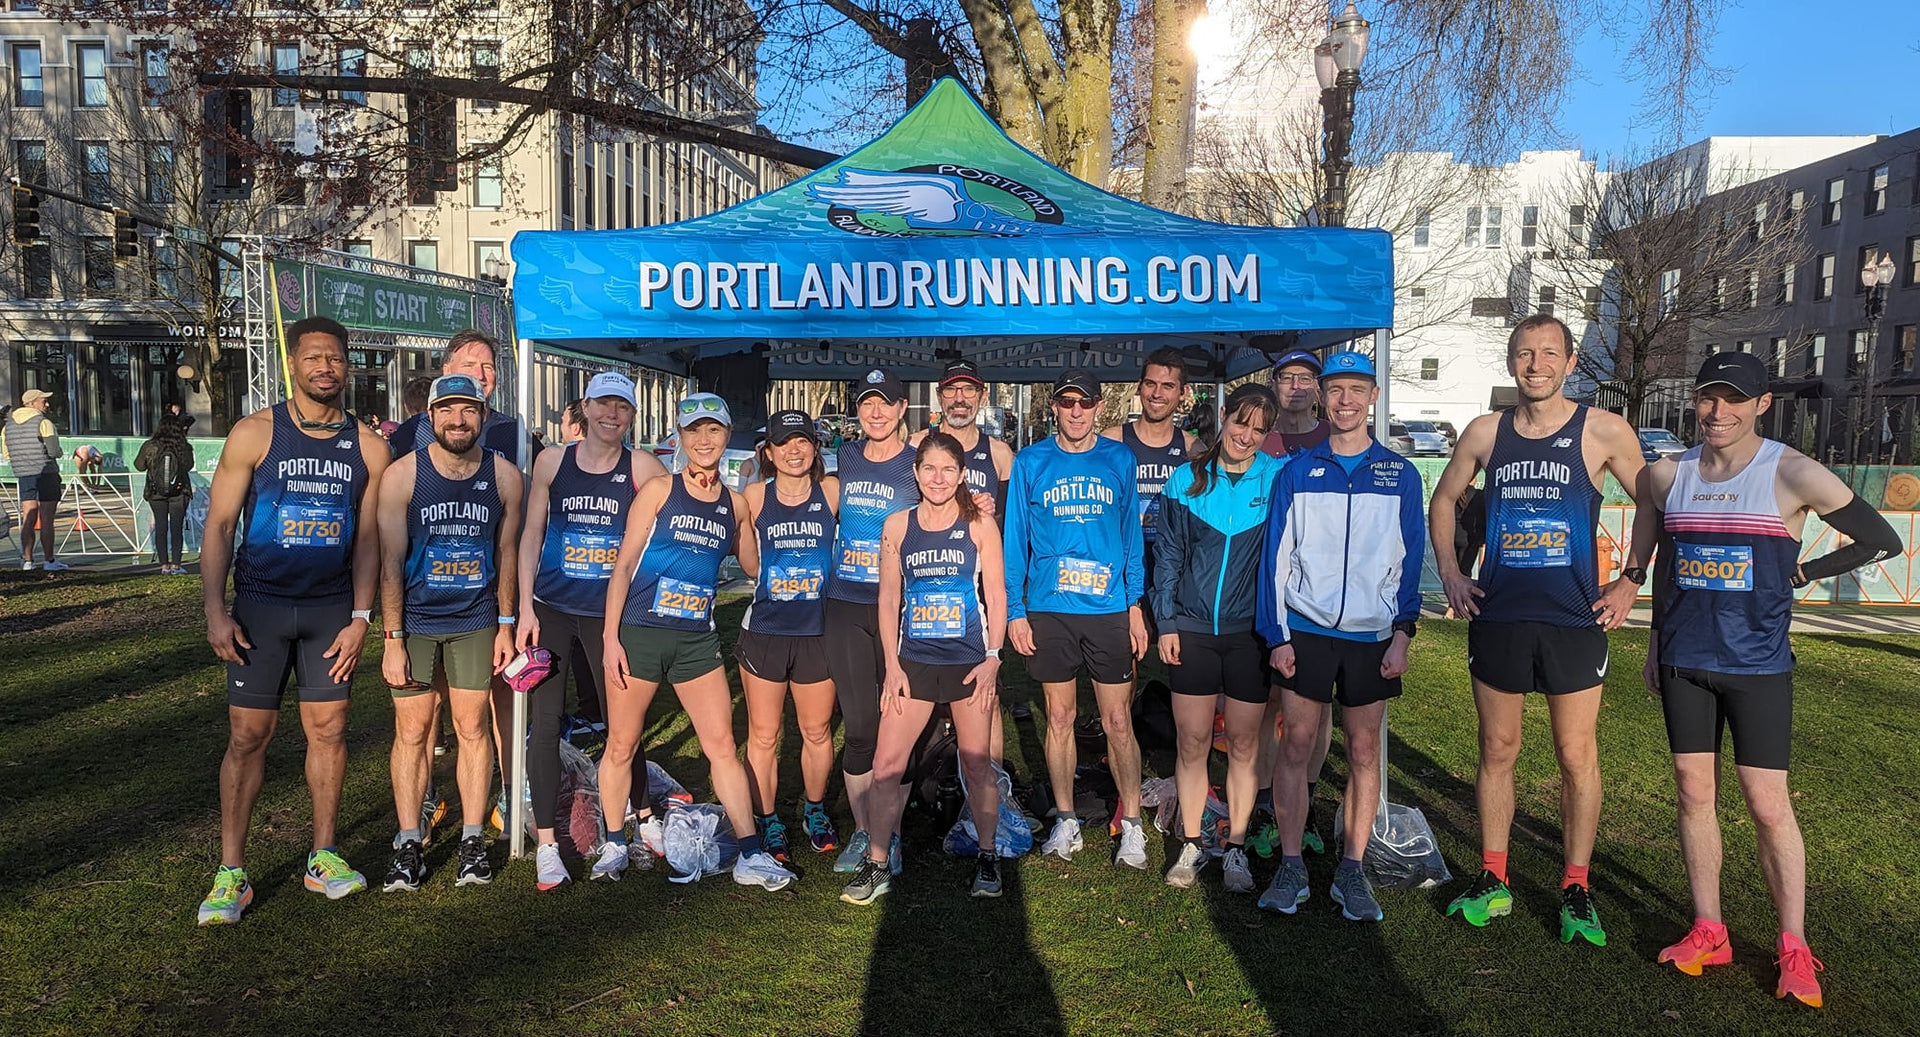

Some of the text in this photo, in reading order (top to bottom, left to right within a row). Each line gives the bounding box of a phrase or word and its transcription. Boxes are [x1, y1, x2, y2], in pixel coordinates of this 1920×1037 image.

[938, 164, 1055, 216] PORTLAND
[639, 253, 1260, 309] PORTLANDRUNNING.COM
[374, 289, 428, 323] START
[278, 458, 352, 482] PORTLAND
[1495, 461, 1570, 486] PORTLAND
[287, 480, 344, 495] RUNNING CO.
[845, 481, 894, 500] PORTLAND
[1043, 482, 1113, 508] PORTLAND
[1501, 486, 1562, 500] RUNNING CO.
[562, 496, 619, 515] PORTLAND
[846, 496, 876, 508] RUNNING
[1692, 493, 1739, 502] saucony
[421, 501, 489, 525] PORTLAND
[1053, 504, 1104, 516] RUNNING CO.
[283, 520, 341, 537] 21730
[568, 513, 612, 526] RUNNING CO.
[669, 515, 726, 540] PORTLAND
[430, 525, 481, 536] RUNNING CO.
[674, 530, 720, 549] RUNNING CO.
[768, 521, 822, 540] PORTLAND
[775, 538, 818, 549] RUNNING CO.
[1502, 531, 1567, 549] 22242
[564, 546, 618, 564] 22188
[843, 550, 878, 567] 21151
[906, 549, 965, 569] PORTLAND
[432, 560, 480, 575] 21132
[913, 566, 959, 577] RUNNING CO.
[1678, 558, 1748, 579] 20607
[770, 577, 821, 593] 21847
[1058, 569, 1108, 589] 20813
[659, 591, 708, 611] 22120
[912, 605, 961, 621] 21024
